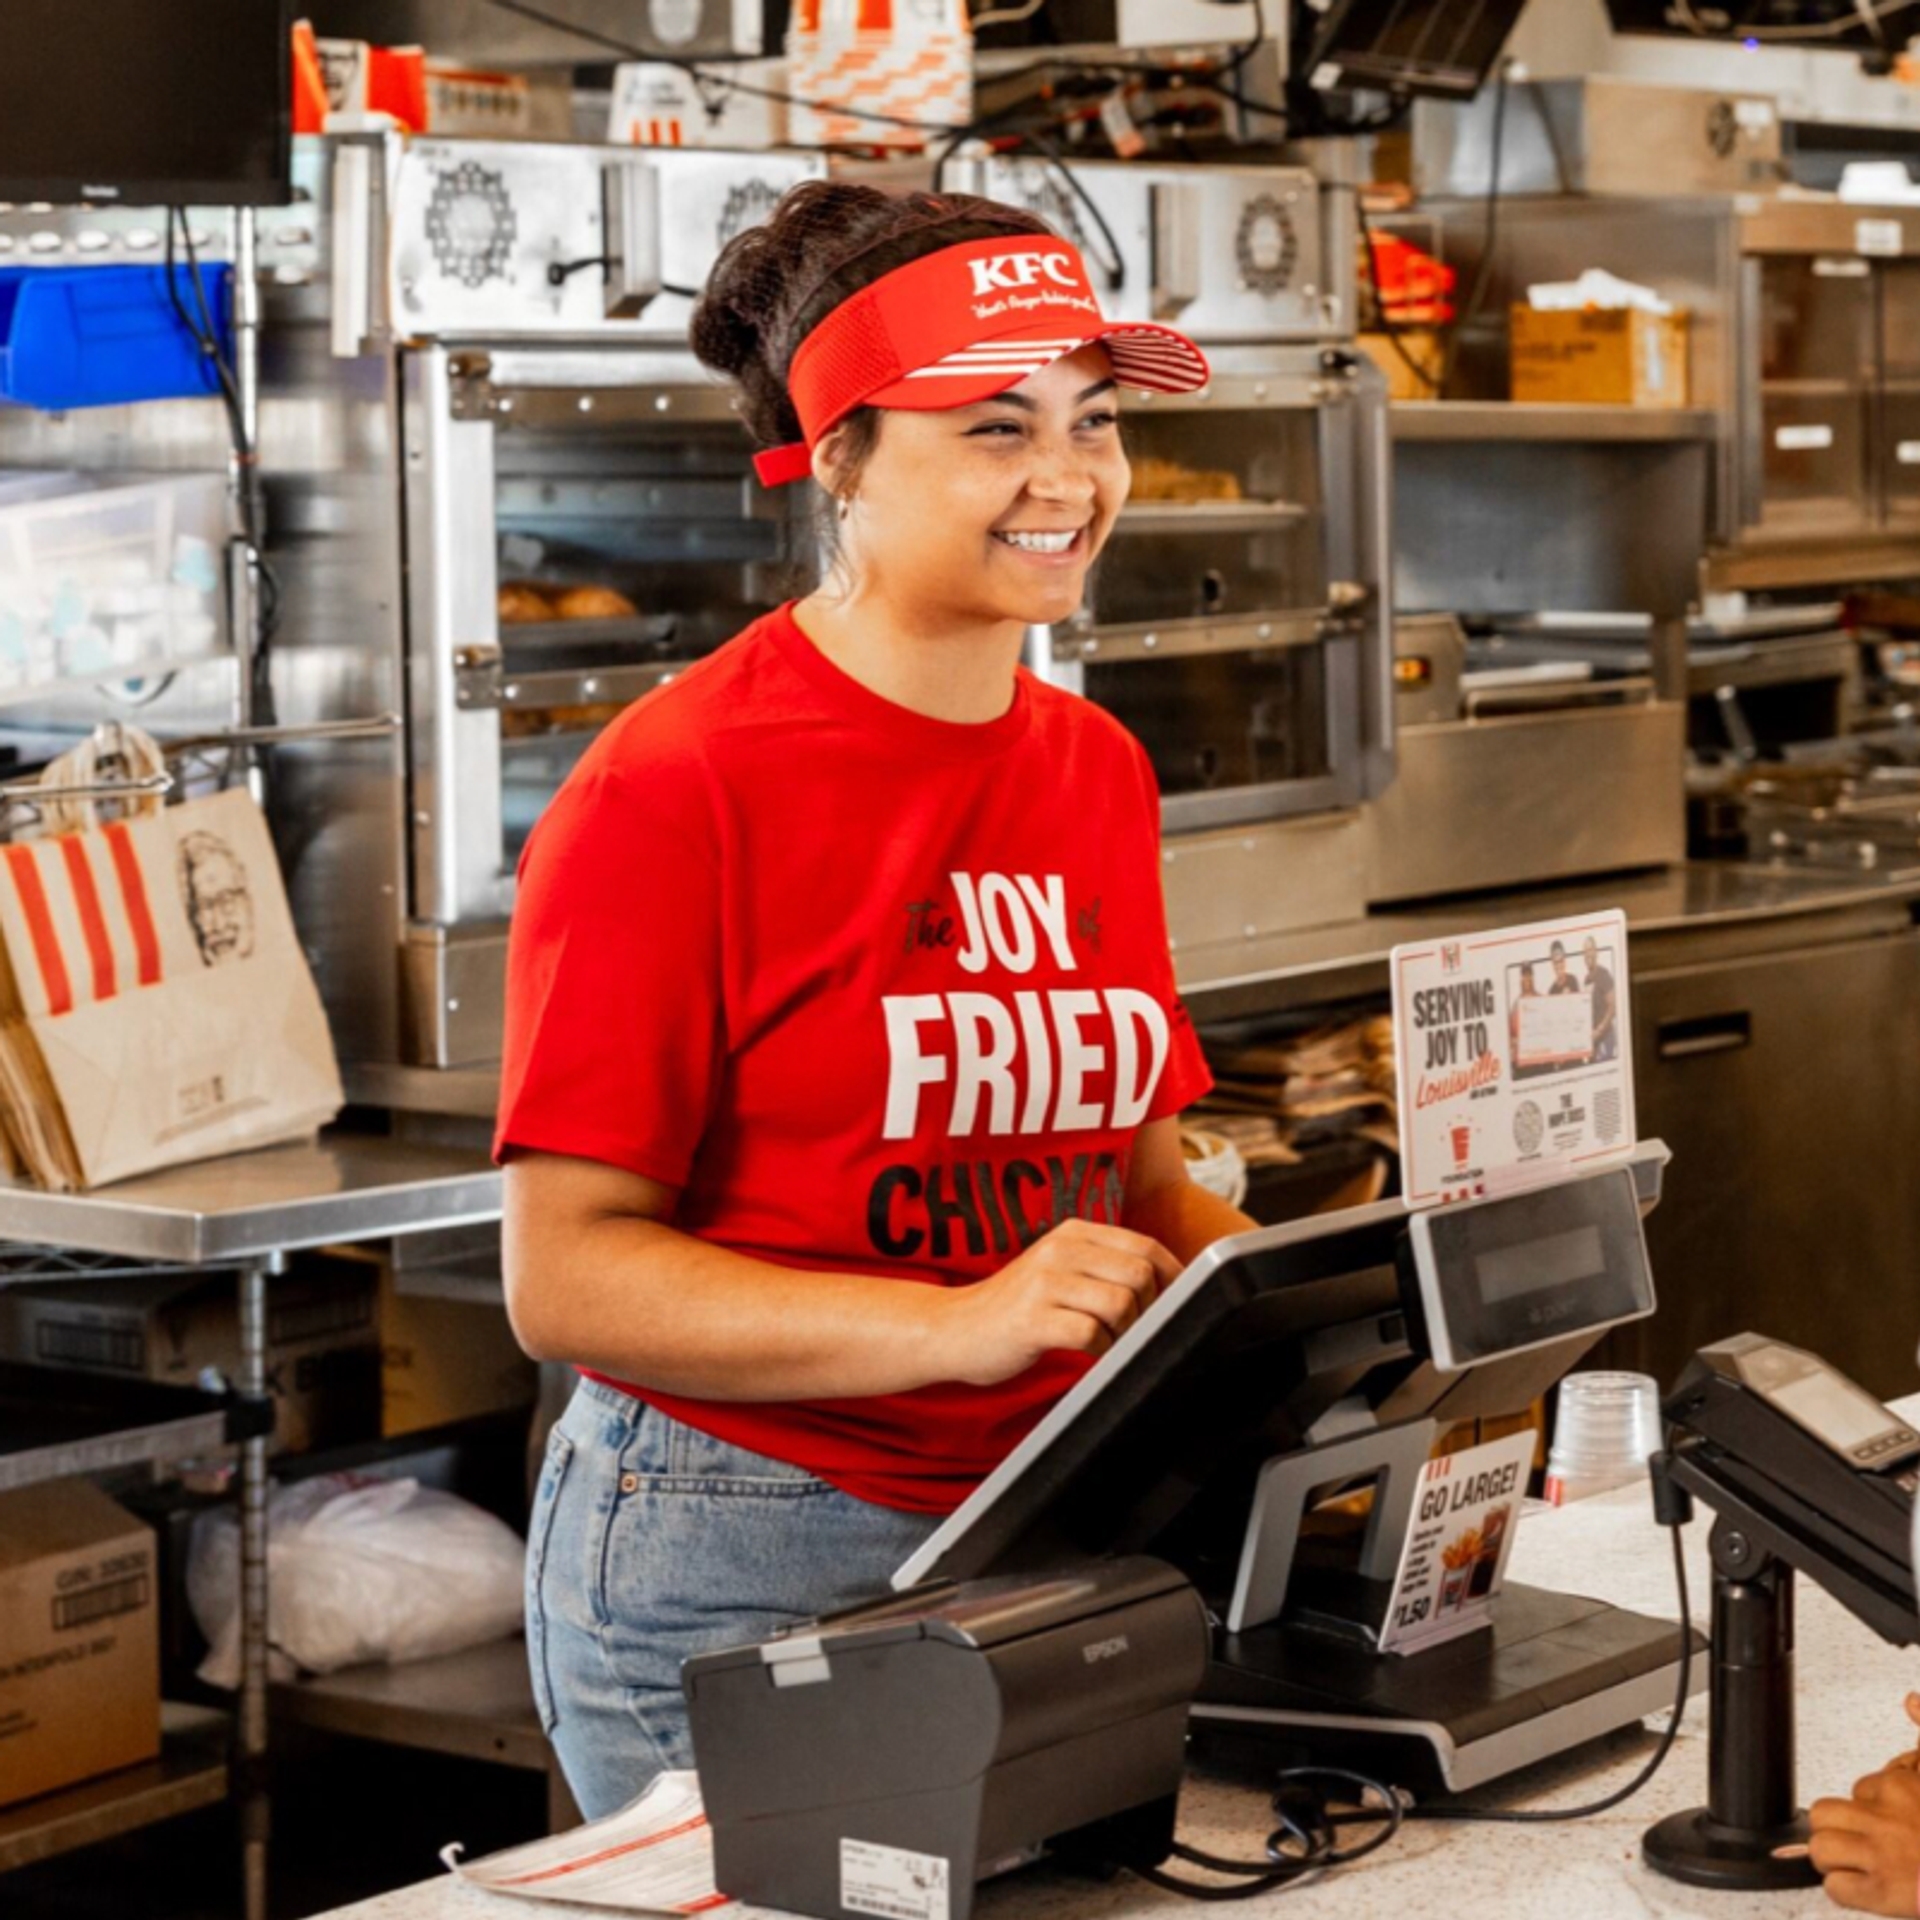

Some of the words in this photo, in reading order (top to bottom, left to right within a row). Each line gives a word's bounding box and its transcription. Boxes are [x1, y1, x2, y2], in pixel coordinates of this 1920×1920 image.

[967, 251, 1078, 296] KFC
[904, 898, 957, 954] The
[949, 871, 1078, 974] JOY
[1412, 978, 1495, 1029] SERVING
[881, 987, 1170, 1140] FRIED
[1425, 1025, 1459, 1070] JOY
[1463, 1021, 1488, 1059] TO
[1415, 1050, 1500, 1110] Louisville
[1419, 1486, 1449, 1523] GO
[1449, 1461, 1520, 1512] LARGE!
[1082, 1634, 1129, 1664] EPSON
